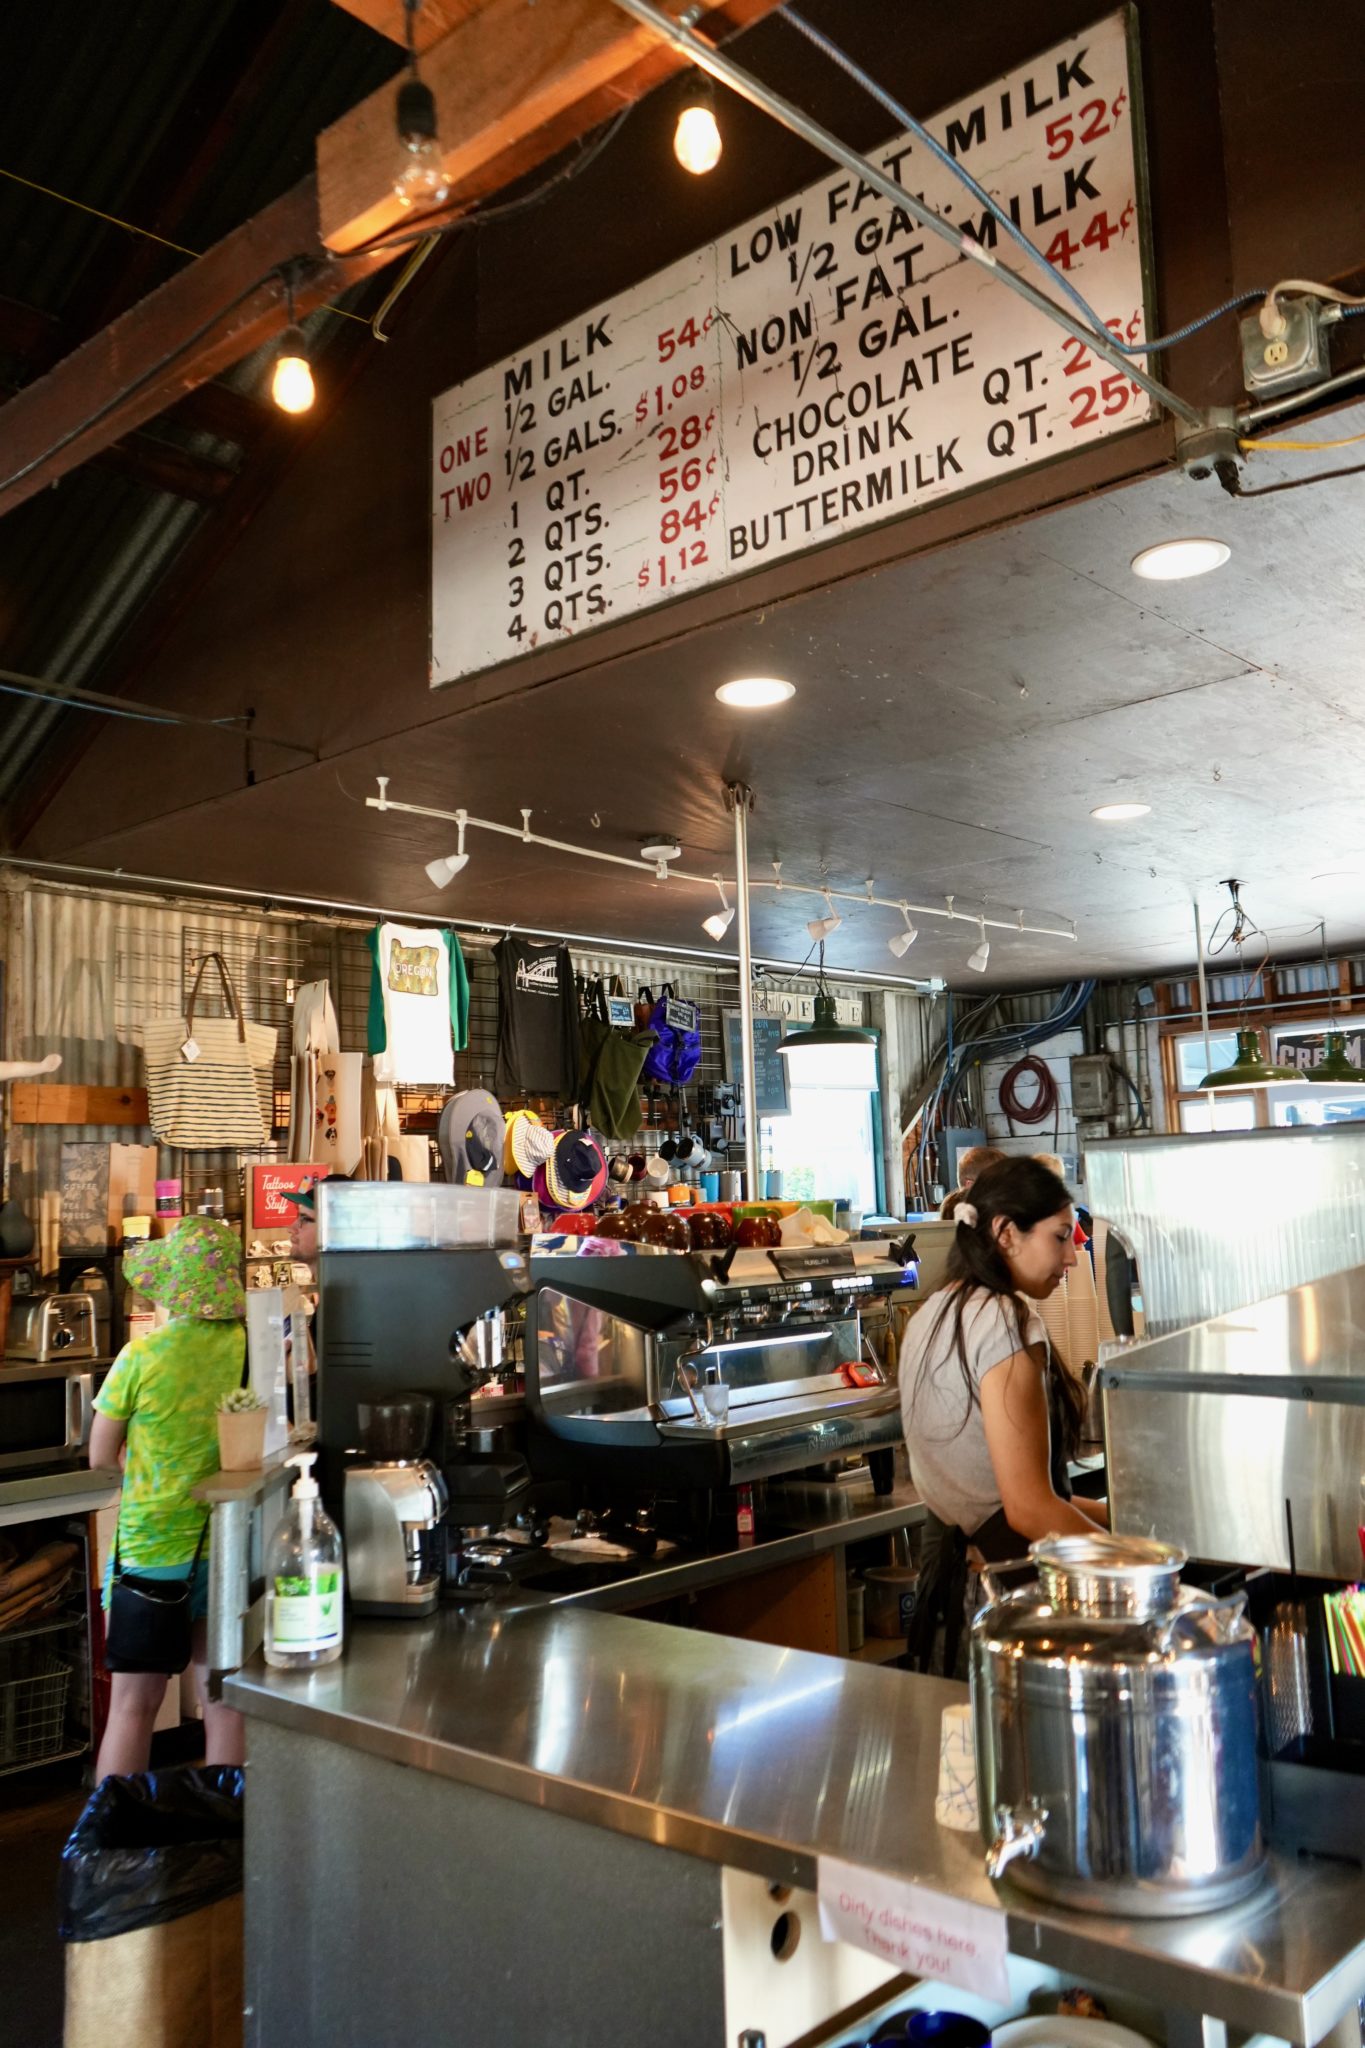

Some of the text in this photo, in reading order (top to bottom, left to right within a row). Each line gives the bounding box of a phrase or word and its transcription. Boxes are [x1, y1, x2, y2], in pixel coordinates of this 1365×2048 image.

[730, 48, 1095, 278] LOW FAT MILK
[788, 242, 839, 296] 1/2
[1045, 86, 1127, 160] 52¢
[737, 156, 1101, 371] NON FAT MILK
[791, 198, 1134, 398] 1/2 GAL. 44¢
[440, 308, 713, 474] ONE 1/2 GAL. 54¢
[504, 314, 613, 401] MILK
[753, 332, 974, 458] CHOCOLATE
[440, 365, 705, 519] TWO 1/2 GALS. $1.08
[510, 408, 715, 529] 1 QT. 28¢
[793, 406, 913, 487] DRINK
[983, 350, 1048, 405] QT.
[508, 449, 716, 569] 2 QTS. 56¢
[730, 436, 963, 561] BUTTERMILK
[987, 403, 1053, 457] QT.
[507, 540, 709, 642] 4 QTS. $1.12
[508, 491, 719, 608] 3 QTS. 84¢
[395, 962, 432, 978] OREGON
[1280, 1036, 1361, 1069] CREM
[262, 1174, 296, 1190] Tattoos
[265, 1195, 288, 1214] Stuff
[839, 1892, 874, 1926] Dirty
[879, 1909, 933, 1941] dishes
[865, 1926, 951, 1974] Thank you!
